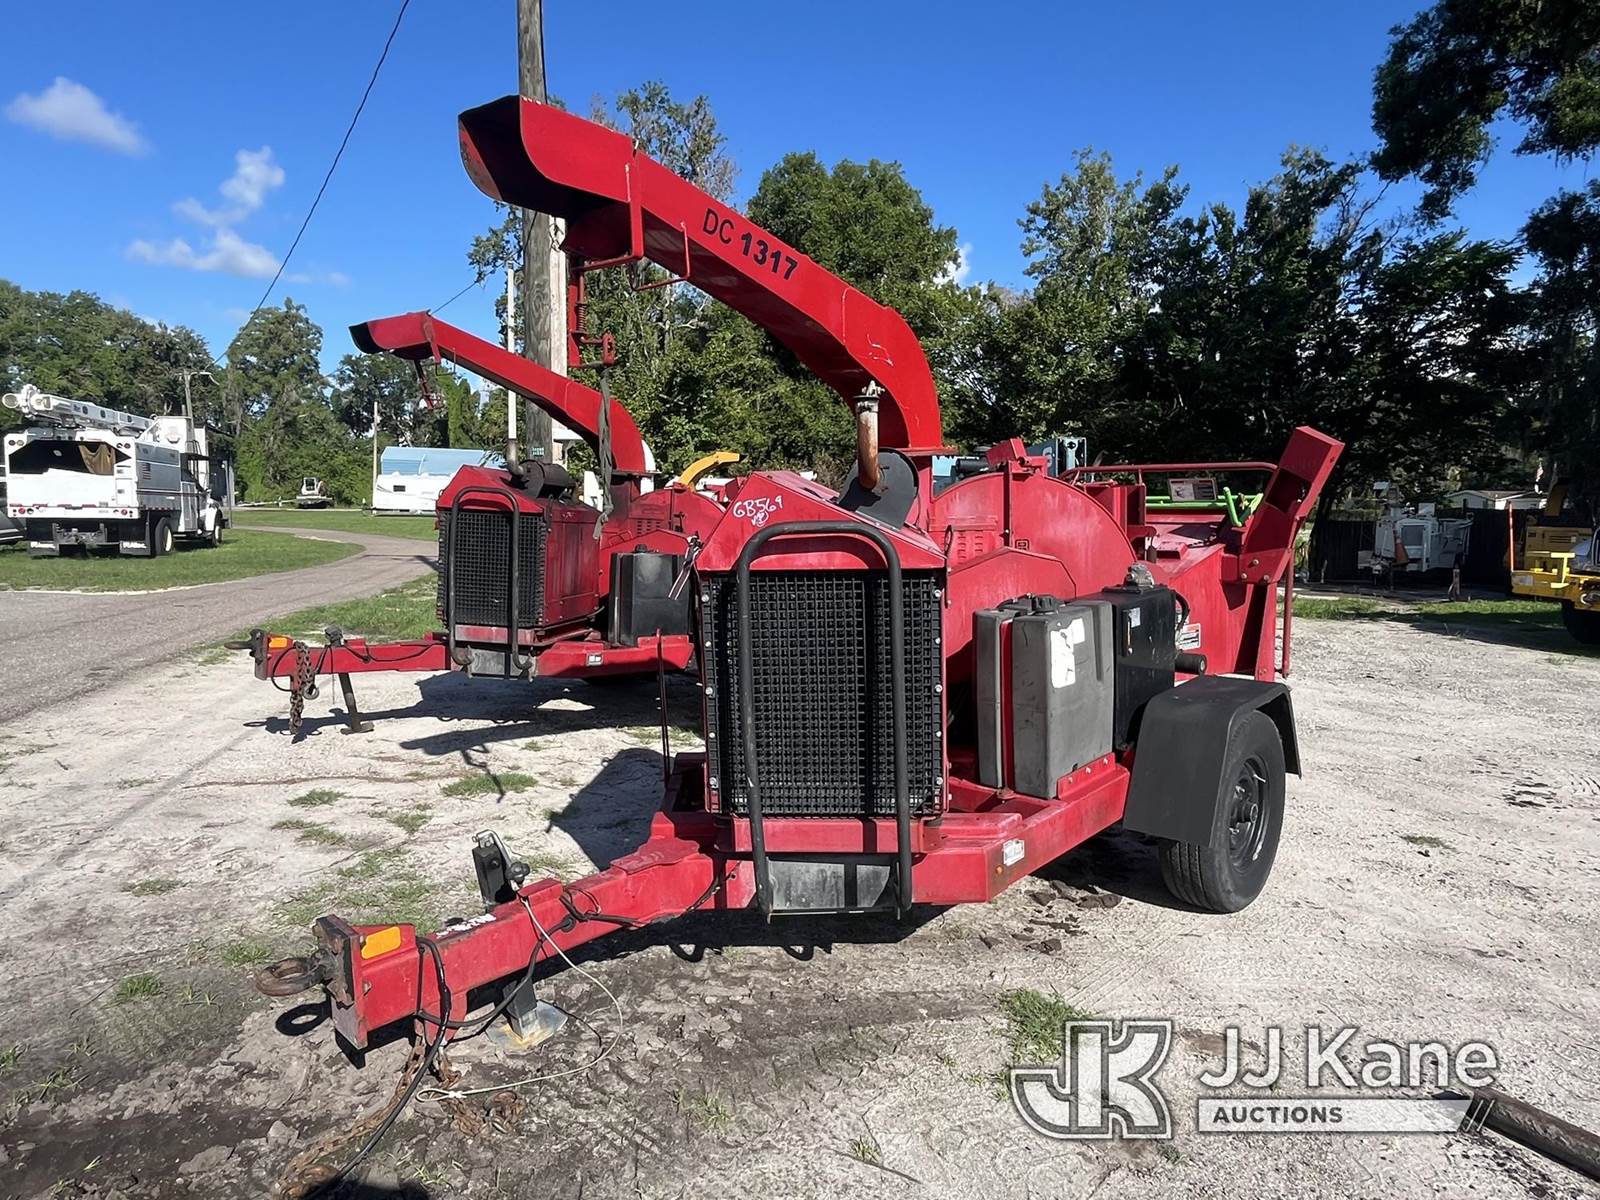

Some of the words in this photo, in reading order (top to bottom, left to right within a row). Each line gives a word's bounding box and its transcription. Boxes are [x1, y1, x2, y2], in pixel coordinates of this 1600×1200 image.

[703, 208, 734, 244] DC
[741, 232, 798, 280] 1317
[732, 495, 783, 518] GB569
